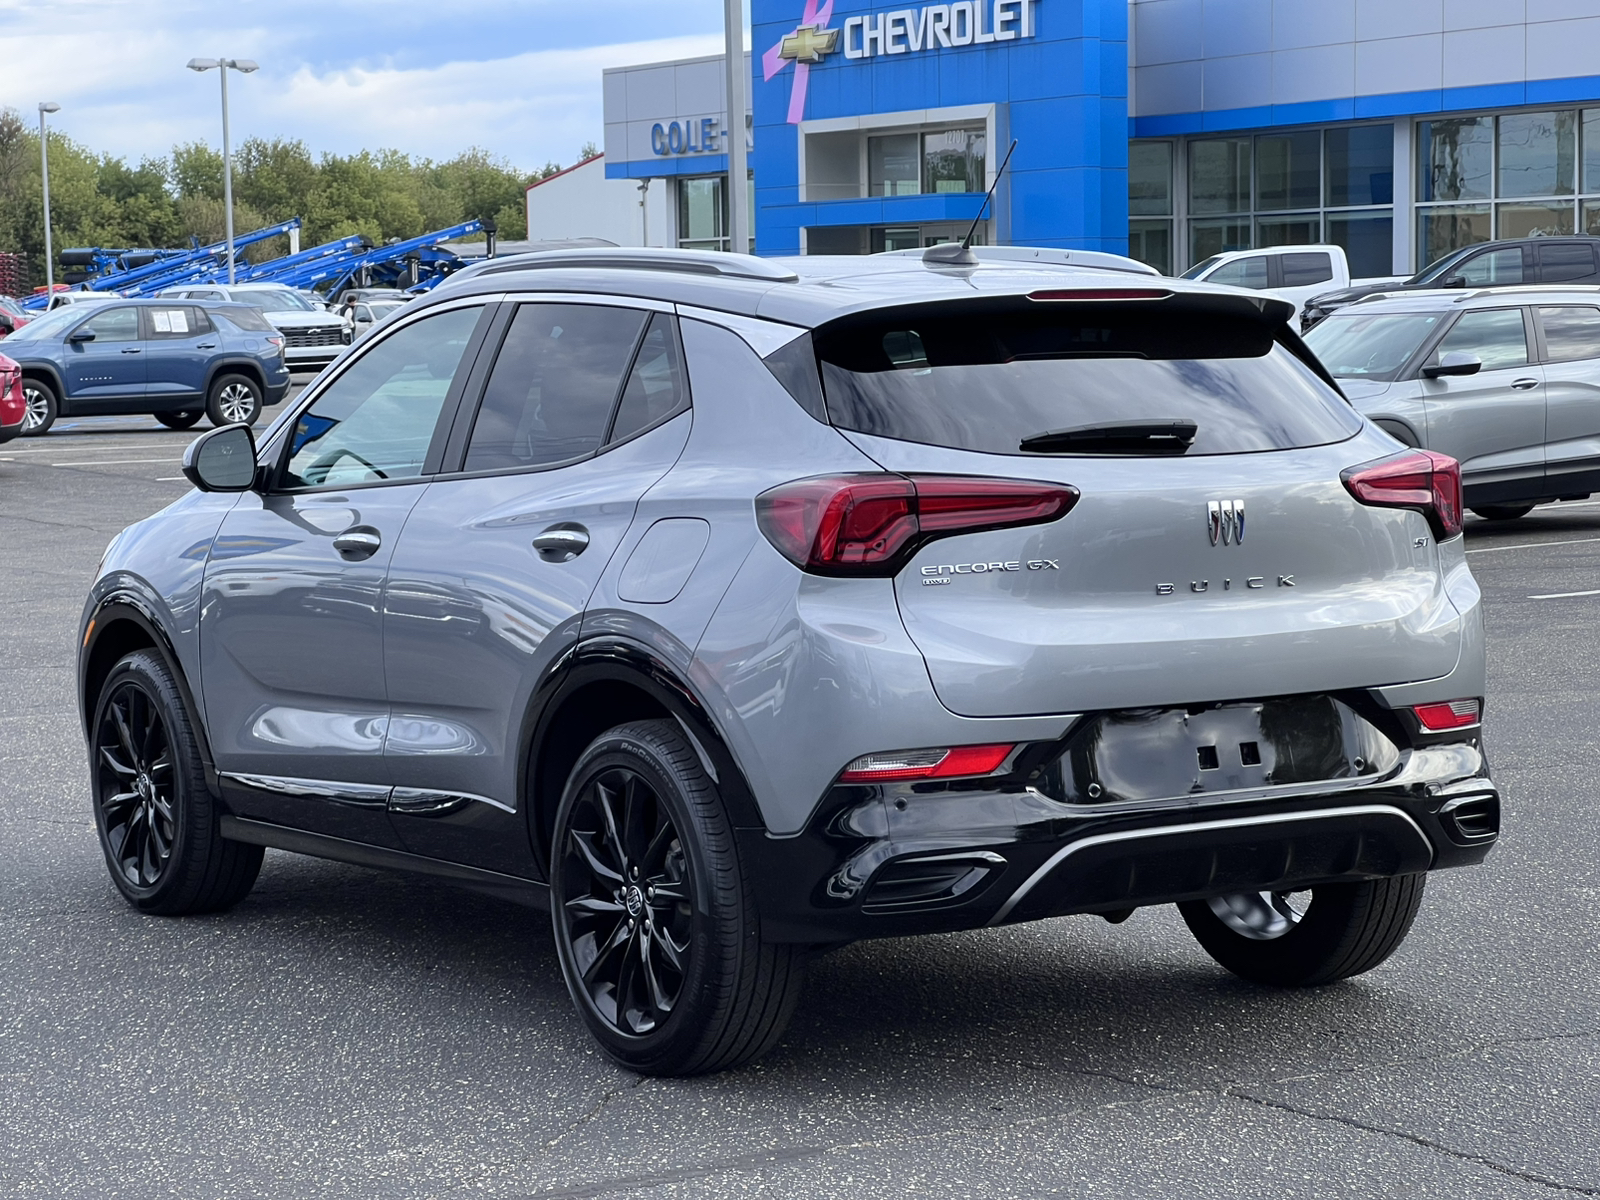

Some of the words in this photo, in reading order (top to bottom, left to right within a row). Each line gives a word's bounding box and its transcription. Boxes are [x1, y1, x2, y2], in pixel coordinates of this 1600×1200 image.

[844, 0, 1037, 59] CHEVROLET
[921, 560, 1020, 576] ENCORE
[1027, 559, 1060, 571] GX
[1156, 574, 1296, 595] BUICK
